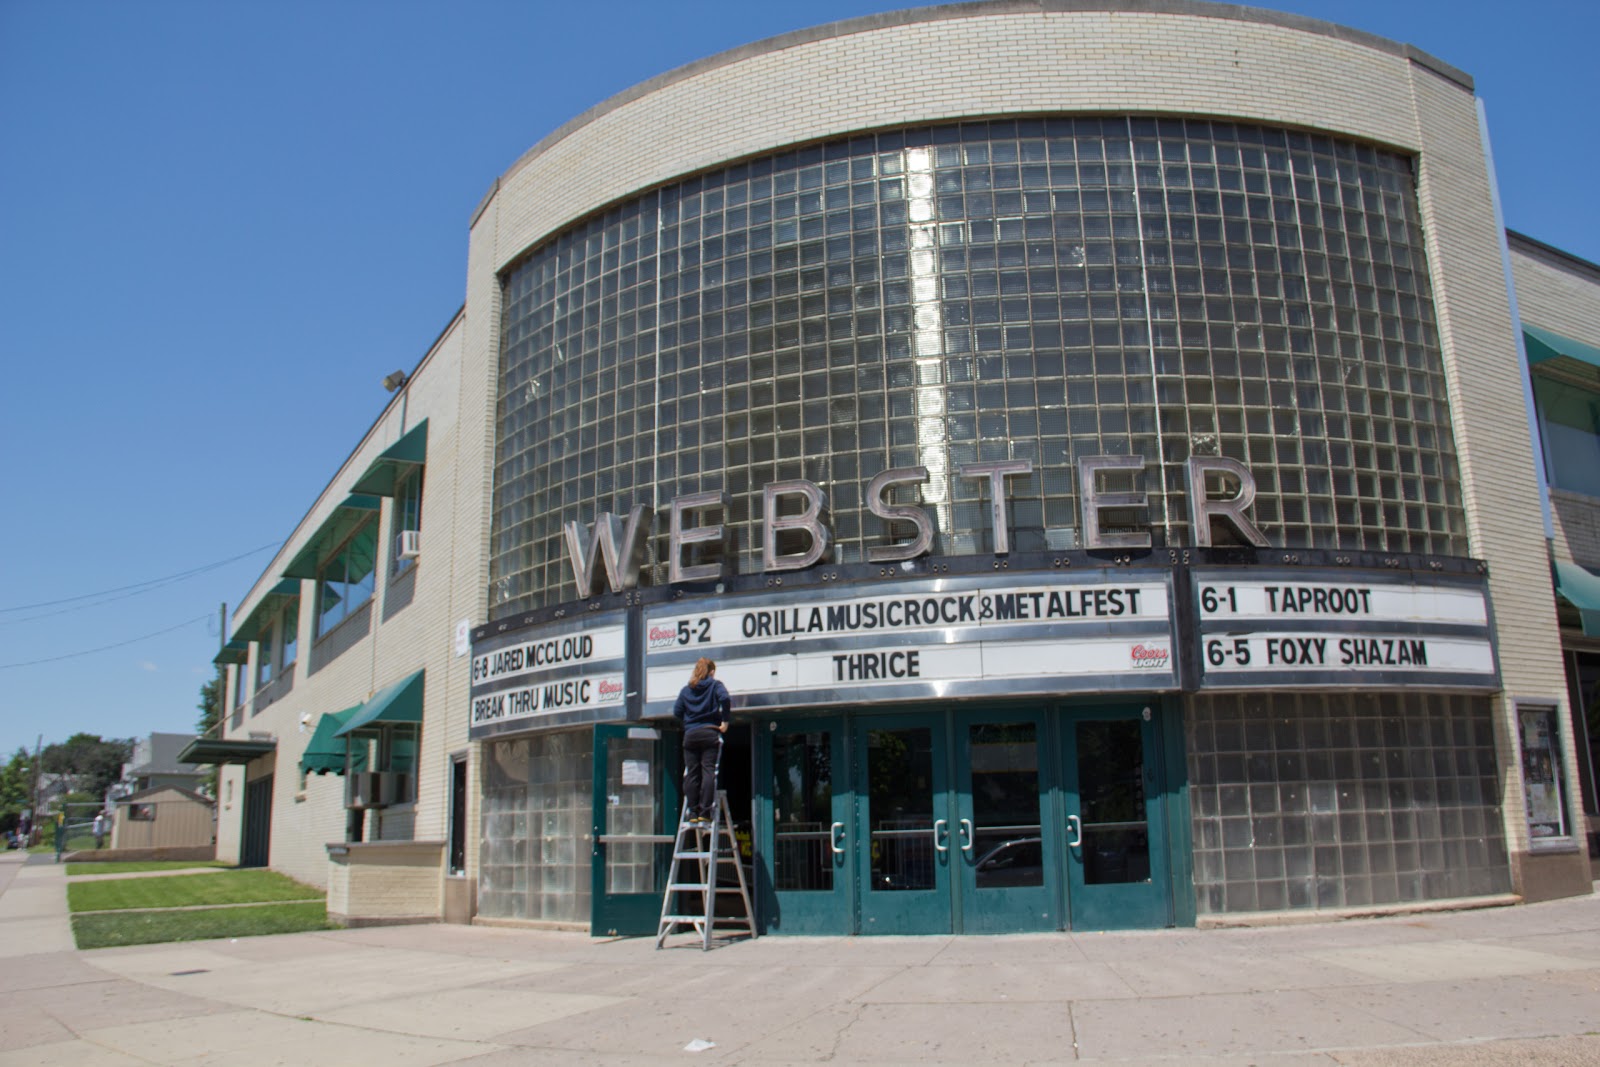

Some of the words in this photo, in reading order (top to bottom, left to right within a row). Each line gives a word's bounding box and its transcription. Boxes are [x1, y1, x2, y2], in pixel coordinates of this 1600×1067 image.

[564, 455, 1272, 600] WEBSTER
[1201, 586, 1236, 613] 6-1
[1265, 587, 1371, 614] TAPROOT
[678, 617, 711, 645] 5-2
[473, 661, 489, 680] 6-8
[490, 650, 524, 675] JARED
[525, 634, 593, 668] MCCLOUD
[1131, 644, 1168, 659] Coors
[1133, 658, 1166, 668] LIGHT
[1207, 640, 1250, 666] 6-5
[1267, 638, 1326, 664] FOXY
[1338, 639, 1428, 665] SHAZAM
[832, 651, 919, 681] THRICE
[475, 695, 505, 722] BREAK
[508, 686, 539, 715] THRU
[542, 680, 591, 709] MUSIC
